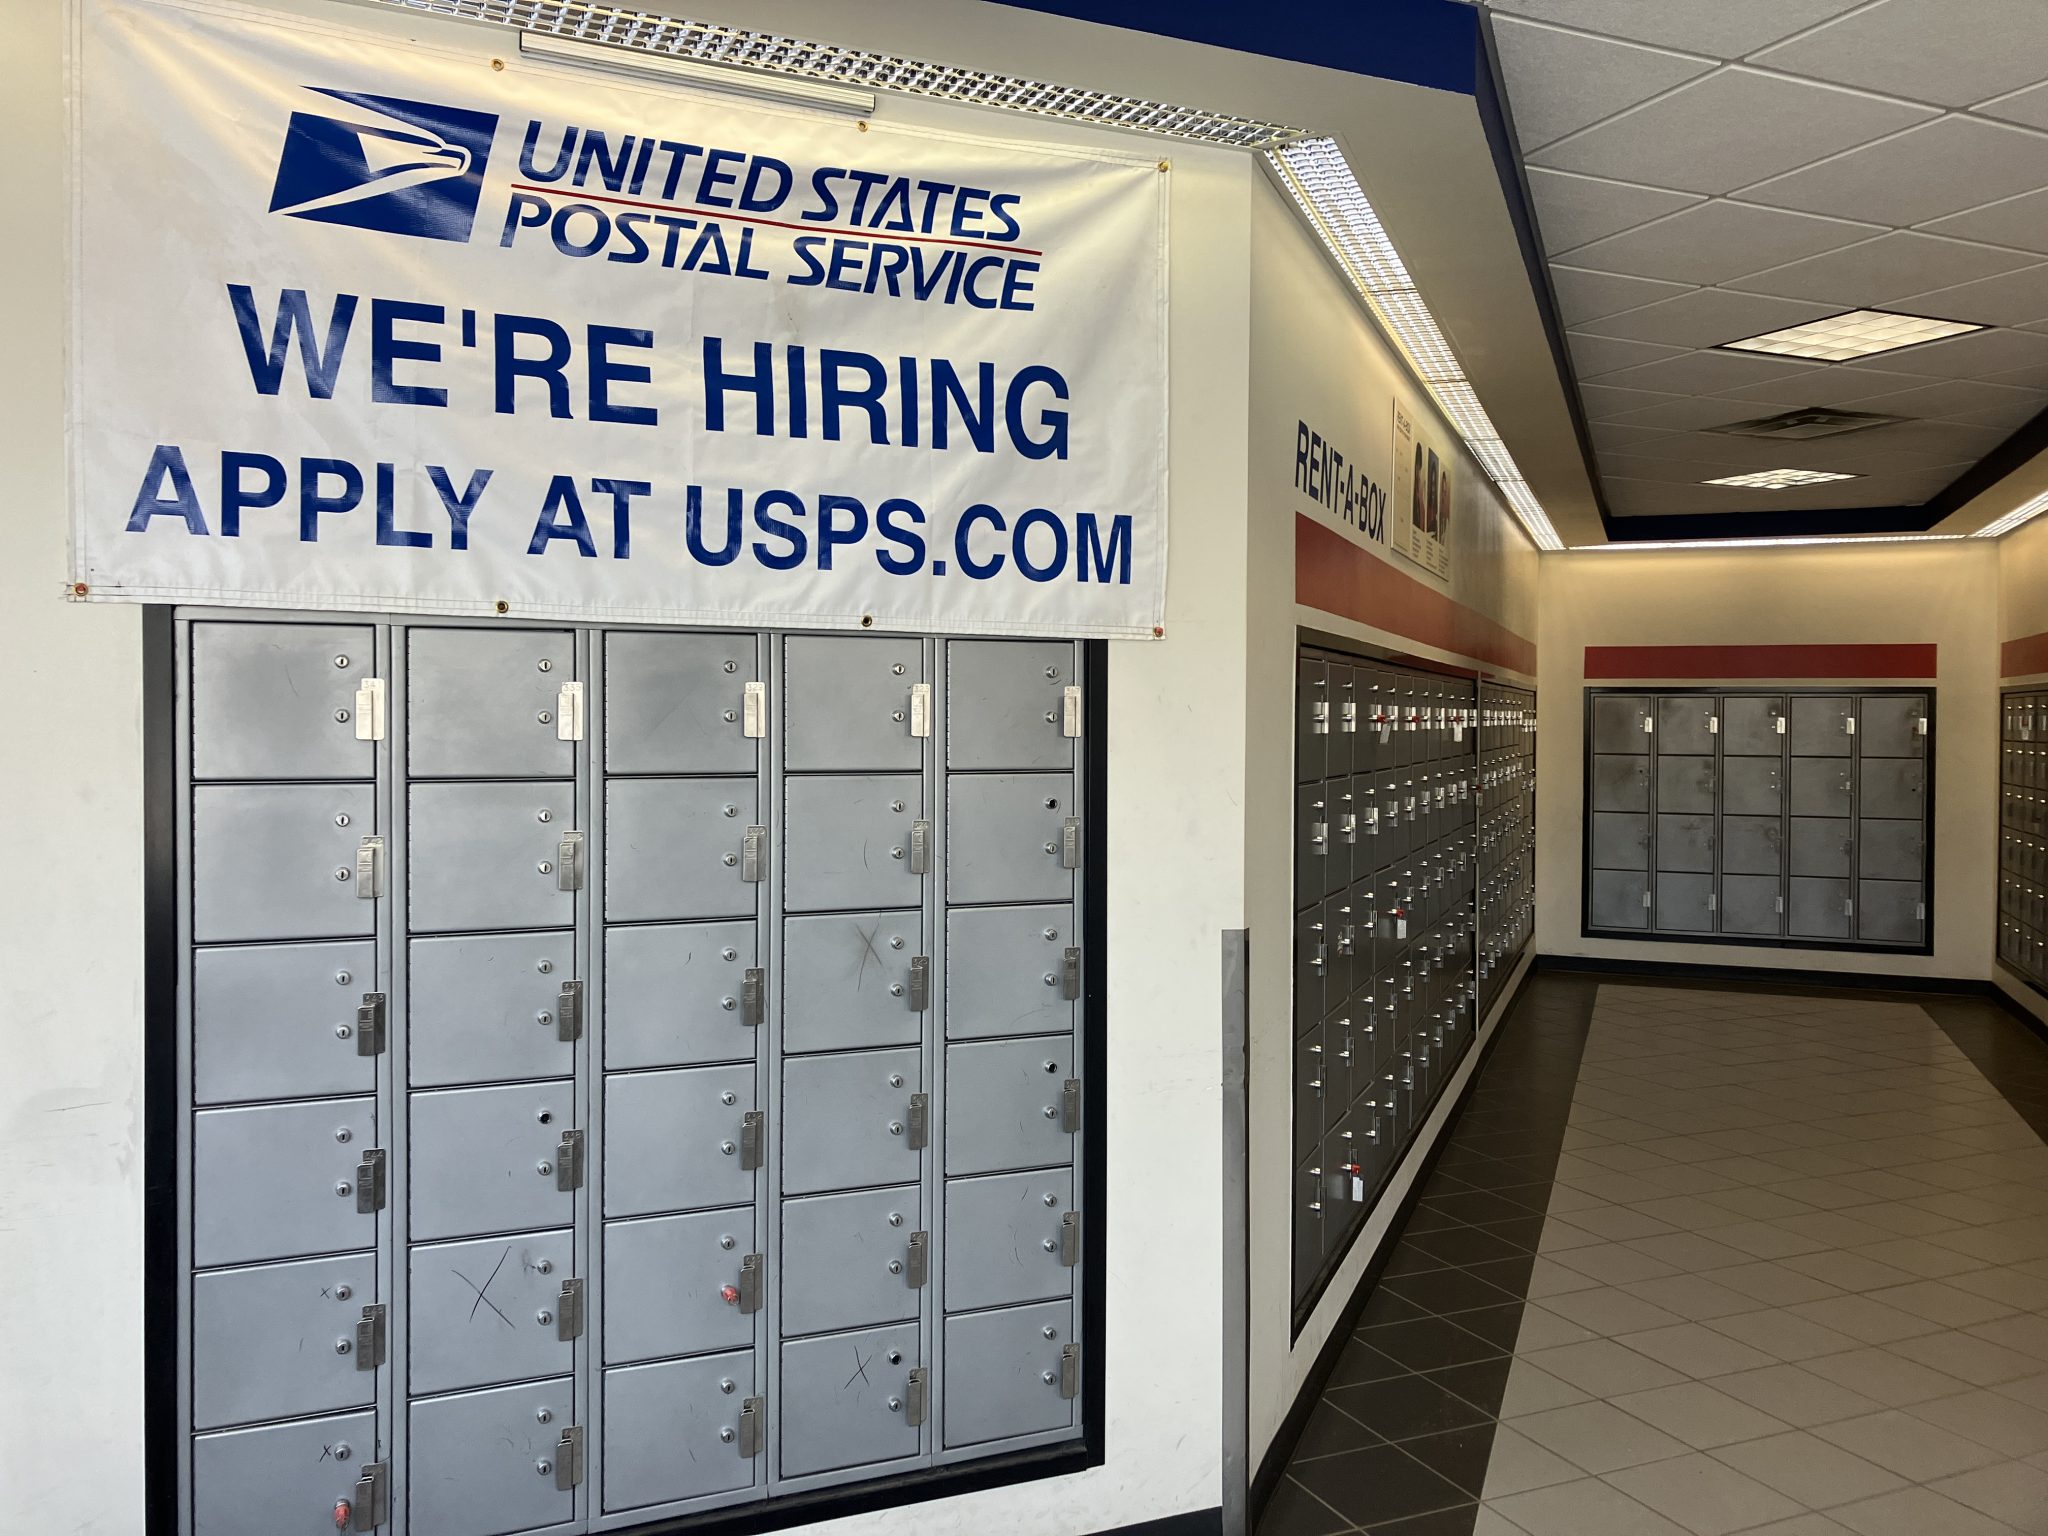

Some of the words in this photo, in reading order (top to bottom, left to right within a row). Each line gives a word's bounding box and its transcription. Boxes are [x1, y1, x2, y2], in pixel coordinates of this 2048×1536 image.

[518, 120, 793, 213] UNITED
[801, 167, 1021, 242] STATES
[500, 195, 769, 280] POSTAL
[787, 236, 1041, 312] SERVICE
[228, 284, 658, 427] WE'RE
[703, 336, 1069, 461] HIRING
[127, 445, 493, 551] APPLY
[527, 474, 652, 560] AT
[685, 484, 1133, 585] USPS.COM
[1294, 419, 1387, 545] RENT-A-BOX
